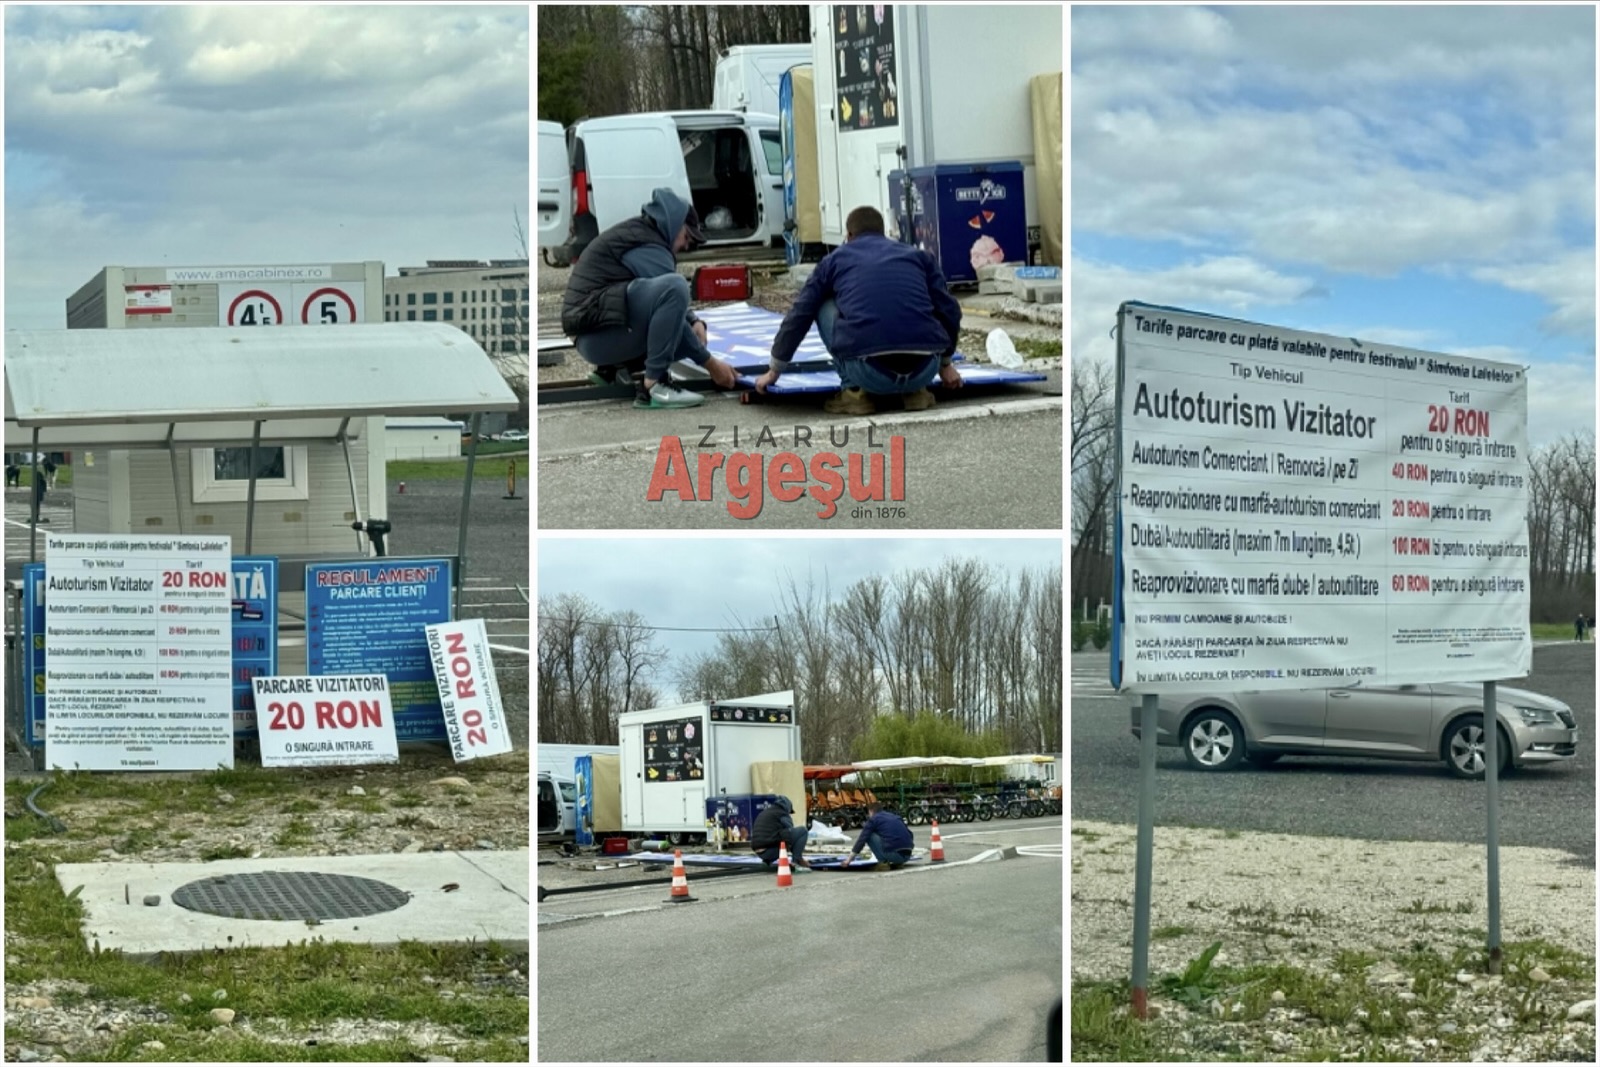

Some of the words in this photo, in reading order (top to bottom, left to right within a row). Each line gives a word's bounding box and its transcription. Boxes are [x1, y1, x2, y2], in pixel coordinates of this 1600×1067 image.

[175, 268, 322, 280] www.amacabinex.ro
[320, 302, 337, 324] 5
[1135, 315, 1172, 336] Tarife
[1177, 325, 1226, 343] parcare
[1230, 332, 1245, 345] cu
[1282, 339, 1326, 358] valabile
[1329, 348, 1365, 363] pentru
[1369, 351, 1417, 370] festivalul
[1427, 359, 1470, 379] Simfonia
[1230, 362, 1251, 378] Tip
[1255, 366, 1304, 384] Vehicul
[1449, 390, 1470, 403] Tarif
[1133, 382, 1277, 430] Autoturism
[1284, 399, 1377, 439] Vizitator
[1428, 404, 1449, 432] 20
[1455, 408, 1490, 437] RON
[1401, 435, 1433, 453] pentru
[1436, 439, 1442, 452] o
[1445, 436, 1482, 459] singură
[1132, 440, 1199, 469] Autoturism
[1203, 446, 1268, 473] Comerciant
[1277, 452, 1325, 478] Remorcă
[1332, 461, 1346, 483] pe
[1348, 457, 1359, 480] Zi
[1392, 462, 1404, 479] 40
[1407, 464, 1428, 480] RON
[1430, 468, 1457, 485] pentru
[1460, 471, 1466, 483] o
[1131, 483, 1221, 514] Reaprovizionare
[1224, 494, 1238, 513] cu
[1329, 498, 1381, 521] comerciant
[1392, 499, 1404, 517] 20
[1407, 500, 1430, 518] RON
[1431, 504, 1456, 522] pentru
[1458, 508, 1464, 519] o
[1233, 528, 1272, 556] (maxim
[1274, 530, 1290, 552] 7m
[1292, 531, 1335, 558] lungime,
[1356, 534, 1361, 559] )
[82, 559, 94, 569] Tip
[96, 559, 124, 568] Vehicul
[186, 560, 202, 568] Tarif
[49, 576, 107, 591] Autoturism
[110, 576, 153, 591] Vizitator
[162, 571, 183, 588] 20
[189, 571, 226, 588] RON
[317, 566, 439, 587] REGULAMENT
[1132, 569, 1229, 598] Reaprovizionare
[1231, 579, 1245, 594] cu
[1282, 573, 1309, 595] dube
[1318, 573, 1379, 596] autoutilitare
[1392, 574, 1404, 591] 60
[1407, 575, 1429, 592] RON
[1432, 576, 1458, 596] pentru
[1461, 579, 1466, 592] o
[330, 587, 381, 599] PARCARE
[1135, 615, 1148, 624] NU
[1150, 615, 1181, 624] PRIMIM
[1183, 615, 1233, 624] CAMIOANE
[1244, 615, 1288, 624] AUTOBUZE
[1289, 615, 1293, 624] !
[427, 628, 452, 698] VIZITATORI
[445, 632, 477, 699] RON
[474, 643, 488, 681] INTRARE
[256, 678, 313, 694] PARCARE
[317, 677, 385, 692] VIZITATORI
[268, 702, 305, 730] 20
[315, 700, 383, 729] RON
[443, 700, 465, 760] PARCARE
[462, 709, 488, 747] 20
[285, 743, 293, 752] O
[294, 740, 335, 752] SINGURĂ
[335, 741, 374, 751] INTRARE
